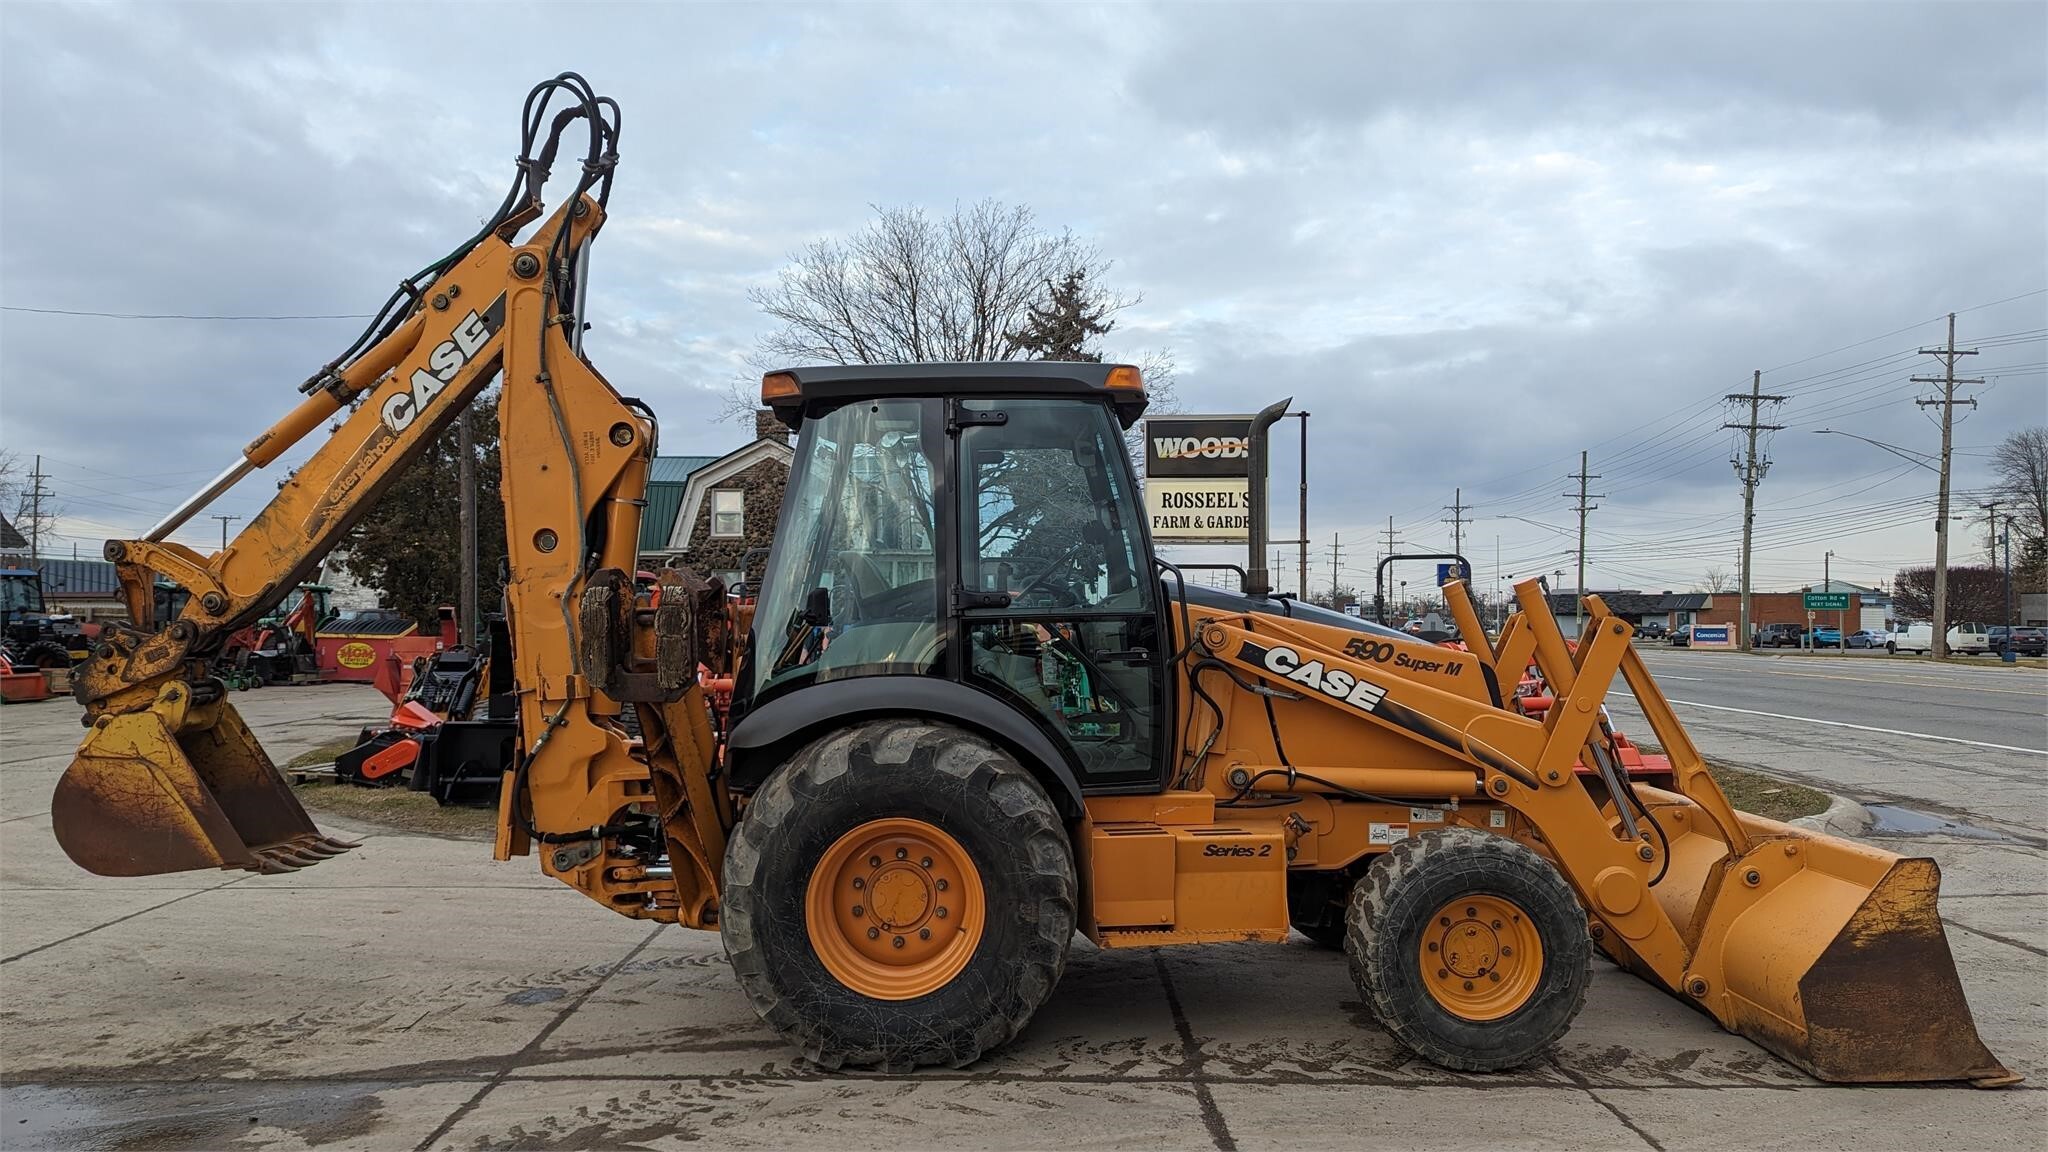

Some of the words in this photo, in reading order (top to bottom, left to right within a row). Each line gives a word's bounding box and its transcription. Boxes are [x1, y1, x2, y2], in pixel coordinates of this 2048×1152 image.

[382, 311, 491, 431] CASE
[330, 435, 393, 503] extendahoe
[1161, 492, 1248, 508] ROSSEEL'S
[1153, 515, 1190, 528] FARM
[1194, 515, 1204, 528] &
[1207, 515, 1248, 528] GARDE
[1343, 638, 1394, 663] 590
[1394, 653, 1443, 672] Super
[1445, 661, 1463, 676] M
[1264, 646, 1387, 712] CASE
[1203, 844, 1256, 857] Series
[1258, 844, 1272, 857] 2
